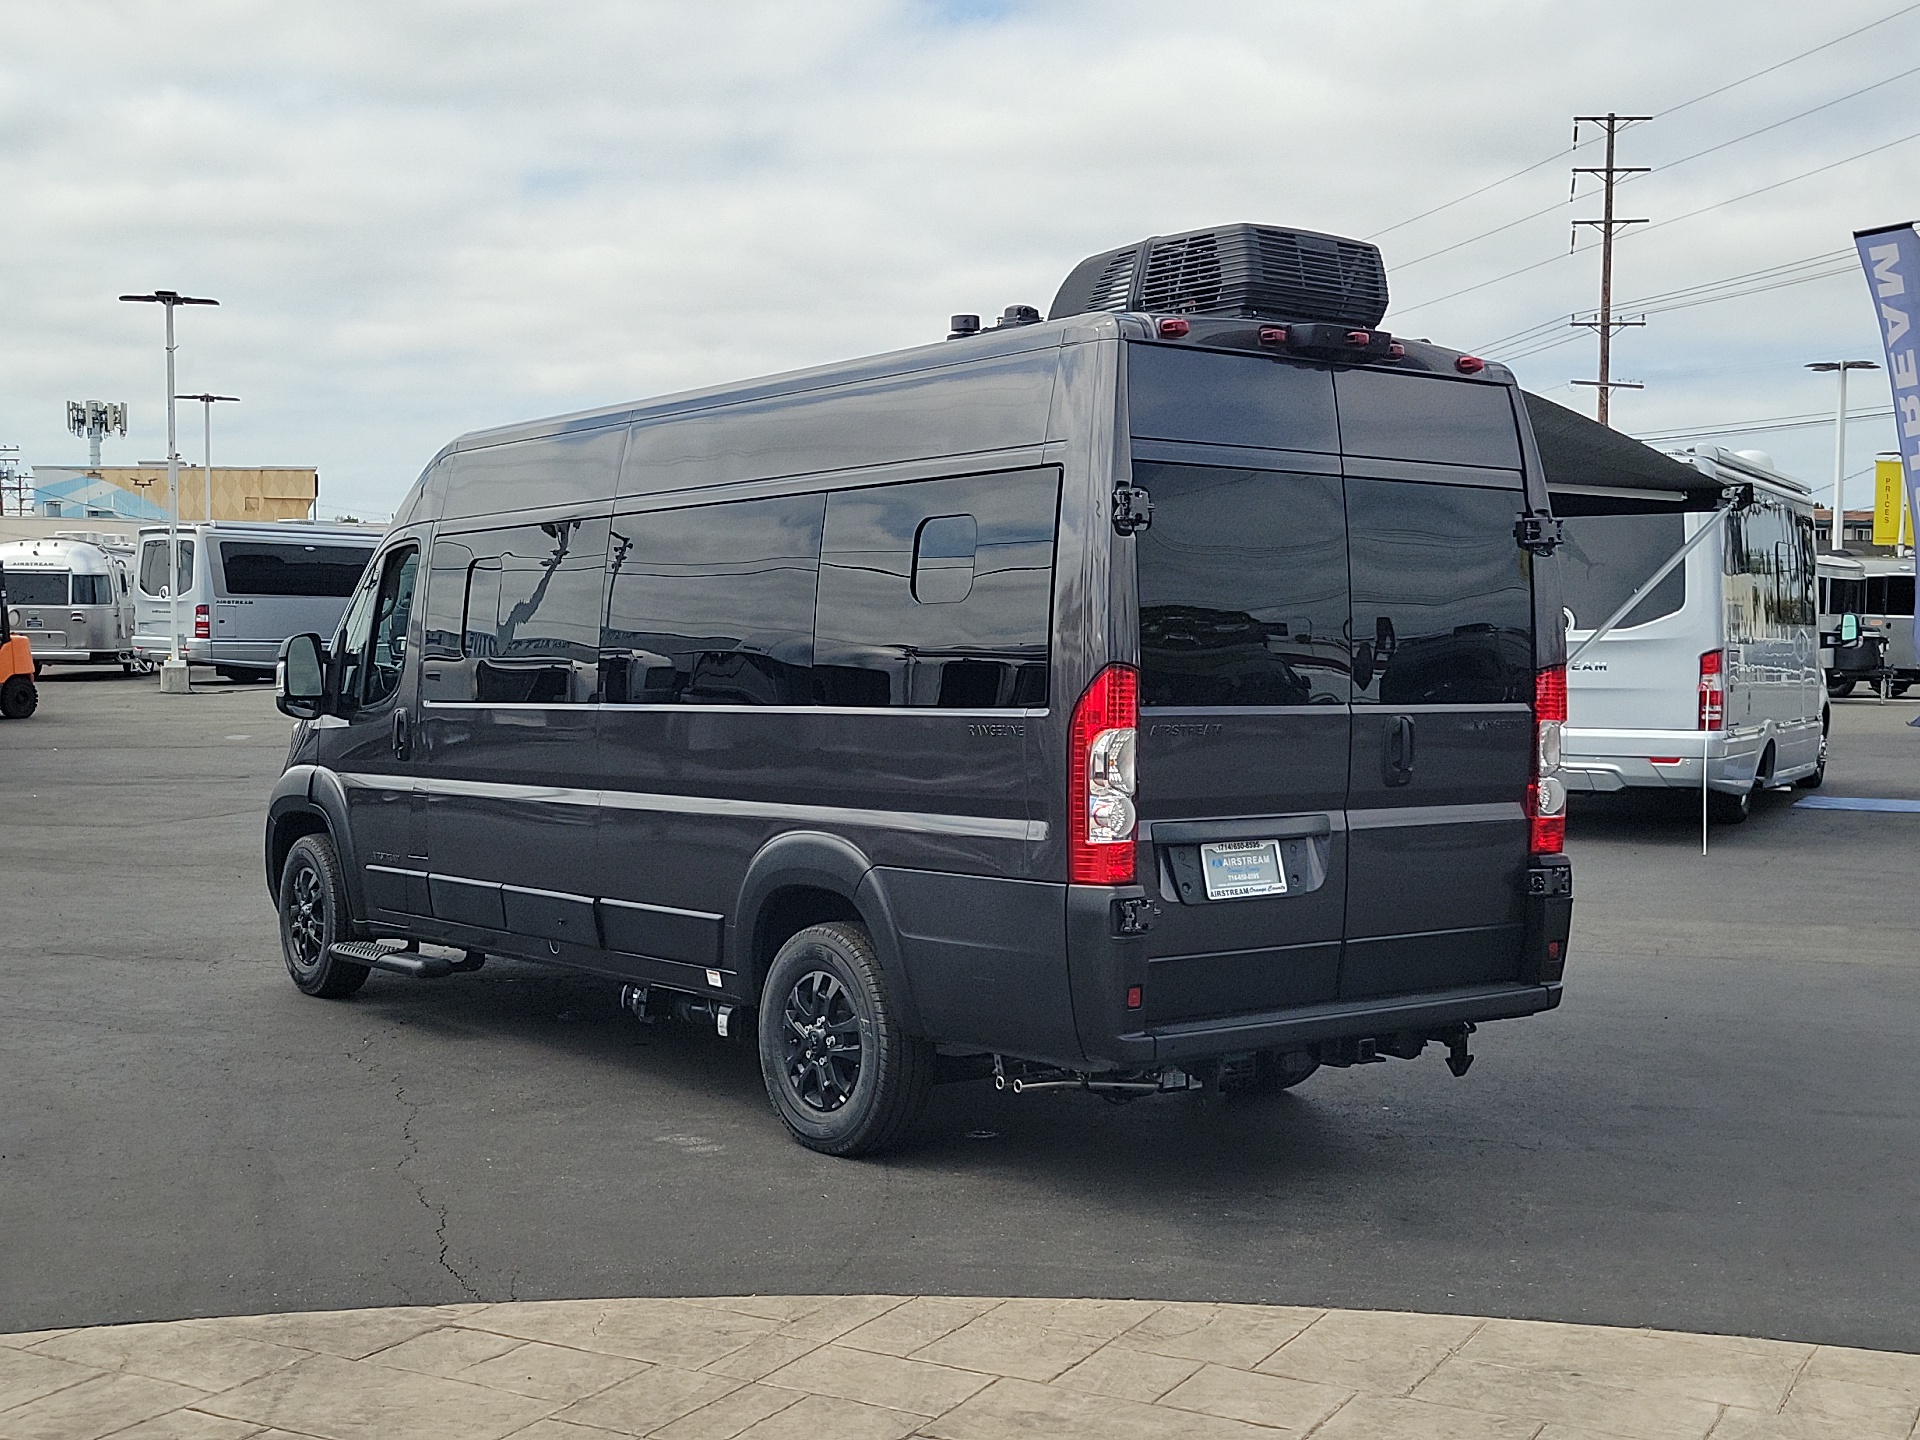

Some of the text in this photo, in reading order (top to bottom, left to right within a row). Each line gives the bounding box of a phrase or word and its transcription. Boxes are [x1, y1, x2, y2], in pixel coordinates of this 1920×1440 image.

[1883, 477, 1891, 524] PRICES
[968, 724, 1024, 736] RANGELINE
[1149, 724, 1223, 736] AIRSTREAM
[1223, 855, 1270, 867] AIRSTREAM
[1210, 887, 1249, 898] AIRSTREAM
